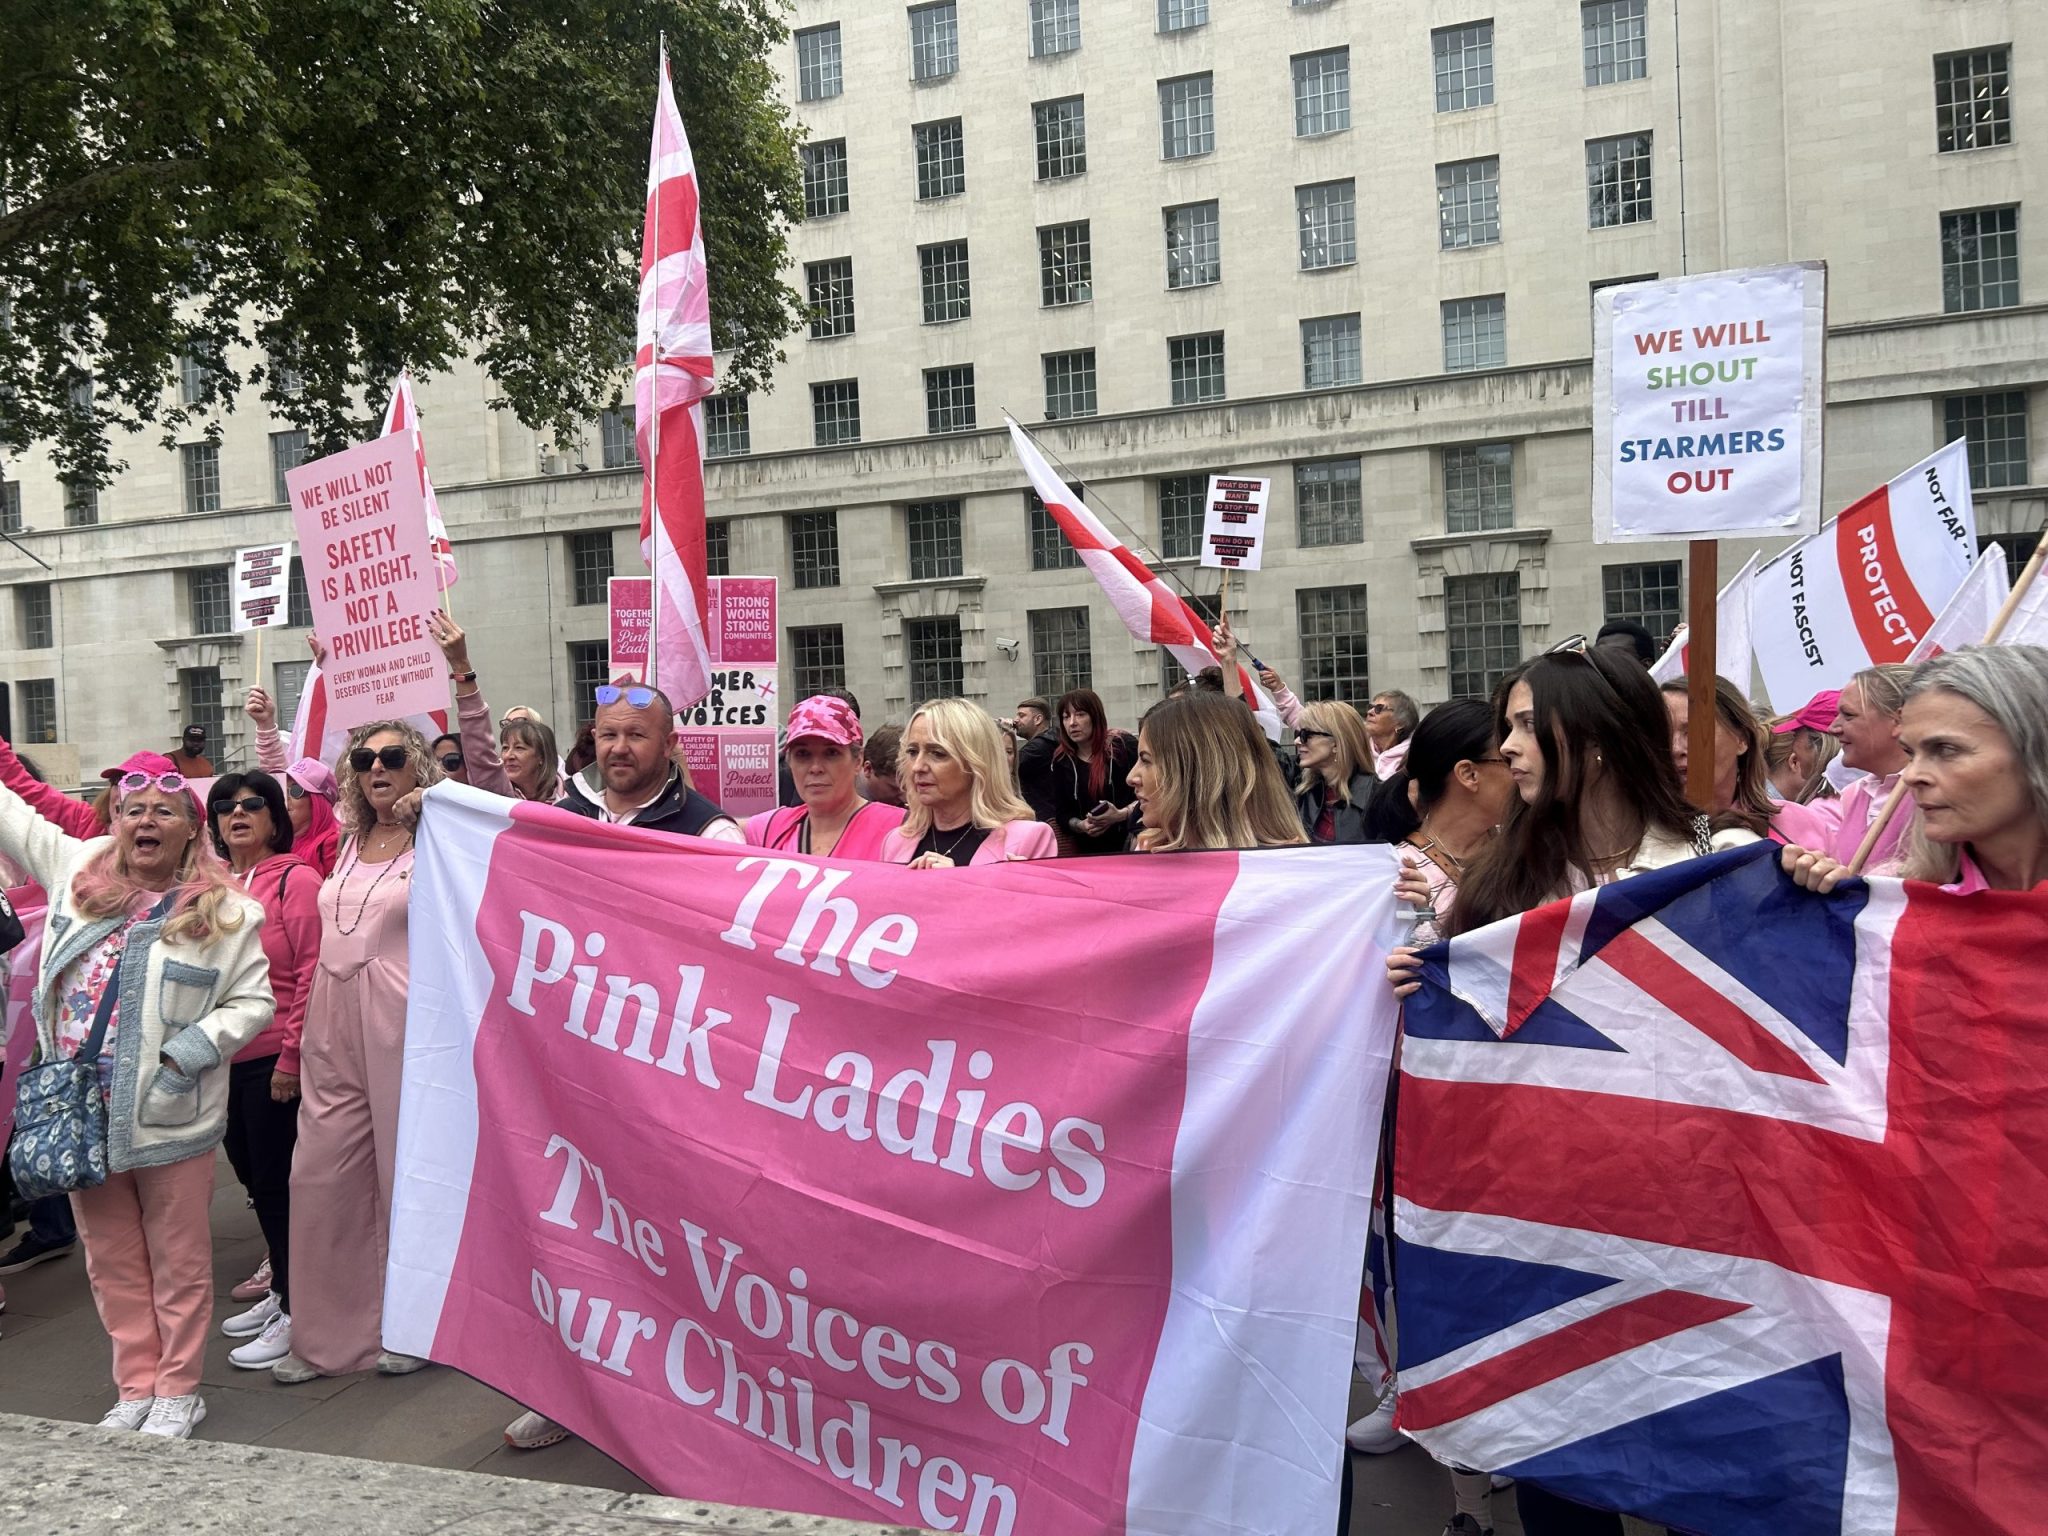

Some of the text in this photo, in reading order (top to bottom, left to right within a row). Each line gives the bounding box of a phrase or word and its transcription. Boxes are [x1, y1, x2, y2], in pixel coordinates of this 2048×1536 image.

[1634, 319, 1770, 356] WE WILL
[1646, 357, 1758, 390] SHOUT
[1671, 397, 1729, 423] TILL
[1620, 428, 1785, 463] STARMERS
[301, 461, 393, 509] WE WILL NOT
[1216, 480, 1237, 489] WHAT
[1667, 468, 1734, 494] OUT
[321, 490, 390, 530] BE SILENT
[1224, 503, 1242, 511] STOP
[1925, 467, 1946, 504] NOT
[1937, 506, 1967, 541] FAR
[326, 524, 396, 569] SAFETY
[1210, 535, 1231, 544] WHEN
[1215, 547, 1236, 555] WANT
[243, 551, 261, 560] WHAT
[321, 554, 417, 602] IS A RIGHT,
[1857, 523, 1917, 646] PROTECT
[344, 590, 399, 626] NOT A
[615, 609, 652, 618] TOGETHE
[725, 596, 770, 608] STRONG
[726, 608, 769, 620] WOMEN
[1790, 550, 1824, 668] NOT FASCIST
[621, 618, 651, 627] WE RIS
[725, 620, 770, 632] STRONG
[332, 614, 423, 660] PRIVILEGE
[617, 641, 647, 654] Ladi
[618, 629, 651, 643] Pink
[724, 632, 773, 640] COMMUNITIES
[333, 651, 431, 685] EVERY WOMAN AND CHILD
[335, 666, 434, 700] DESERVES TO LIVE WITHOUT
[376, 691, 395, 705] FEAR
[679, 704, 767, 726] VOICES
[725, 744, 771, 755] PROTECT
[727, 757, 769, 769] WOMEN
[725, 770, 772, 785] Protect
[723, 787, 774, 798] COMMUNITIES
[720, 855, 919, 990] The
[505, 909, 1106, 1209] Pink Ladies
[539, 1132, 1094, 1447] The Voices of
[531, 1267, 1018, 1536] our Children
